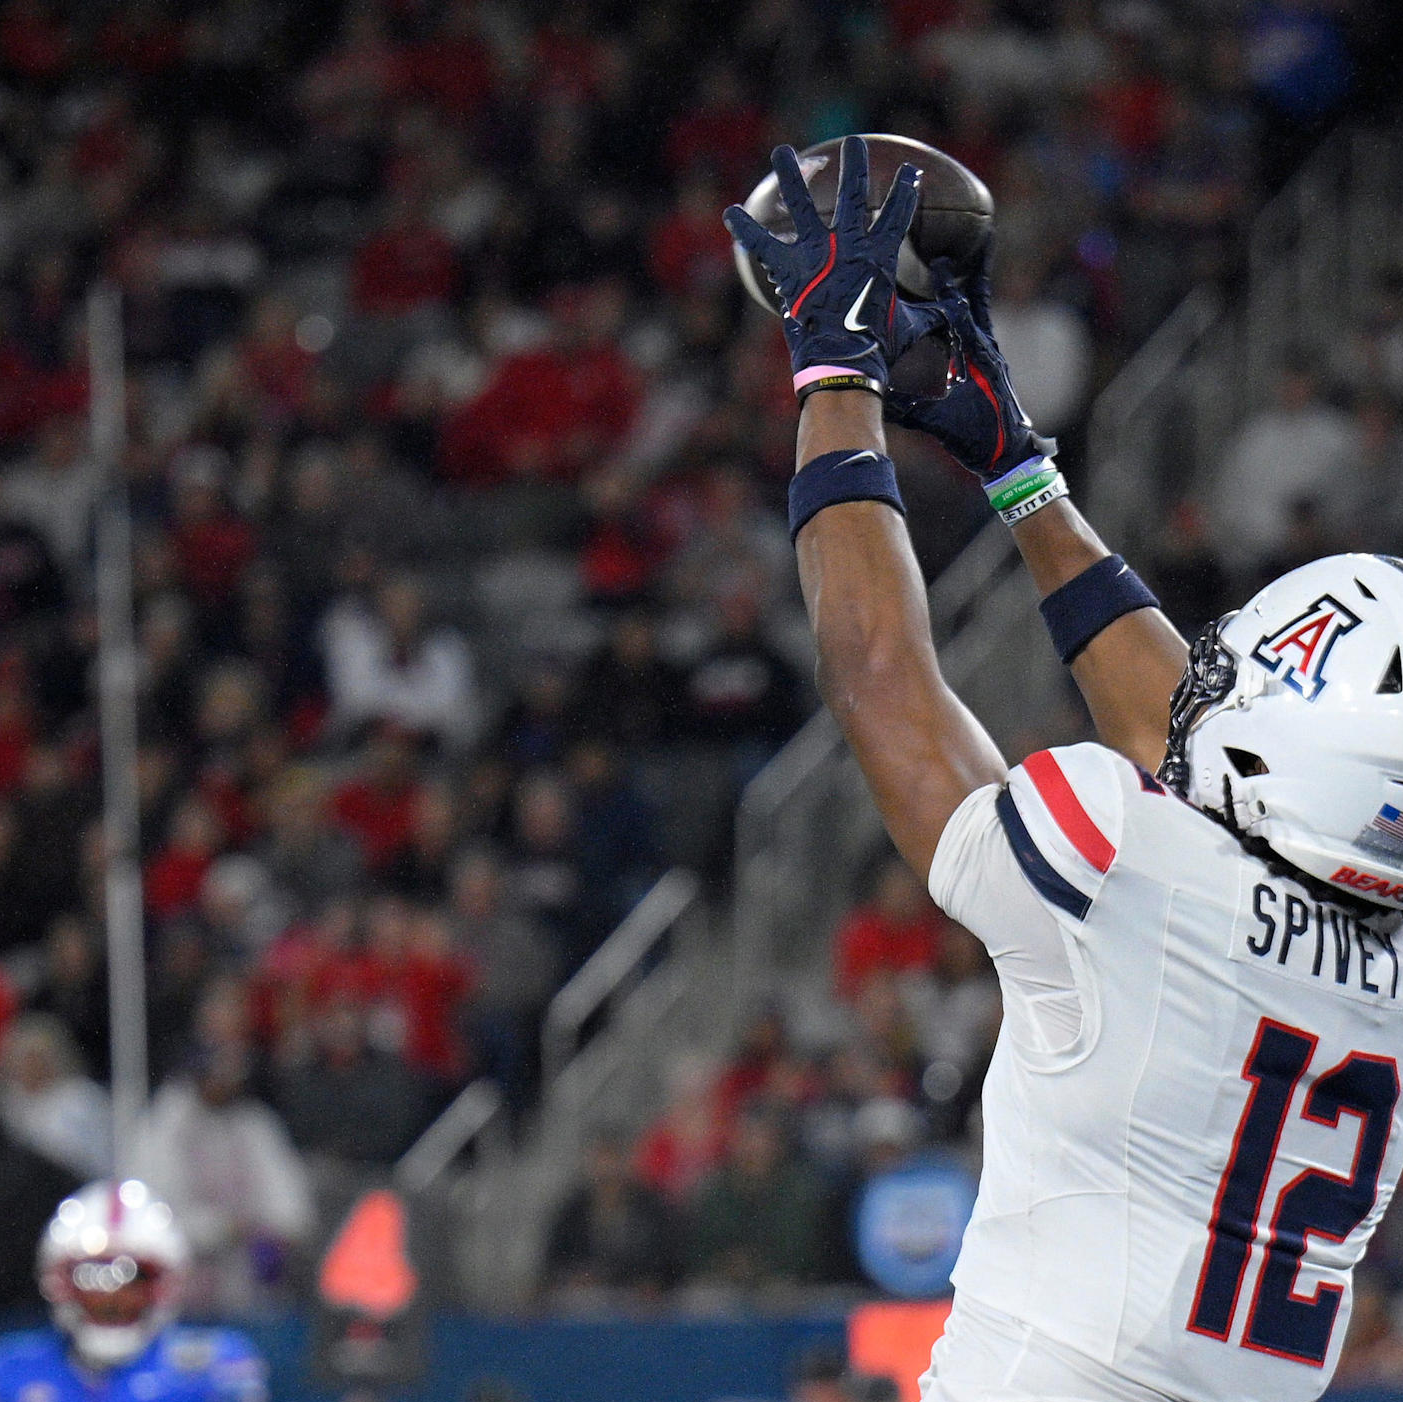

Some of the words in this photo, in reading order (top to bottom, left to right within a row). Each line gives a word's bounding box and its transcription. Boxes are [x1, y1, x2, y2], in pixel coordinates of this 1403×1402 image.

[1002, 506, 1022, 521] GET
[1024, 498, 1037, 512] IT
[1039, 490, 1053, 504] IN
[1249, 593, 1363, 703] A
[1246, 882, 1401, 1000] SPIVEY
[1185, 1015, 1401, 1369] 12
